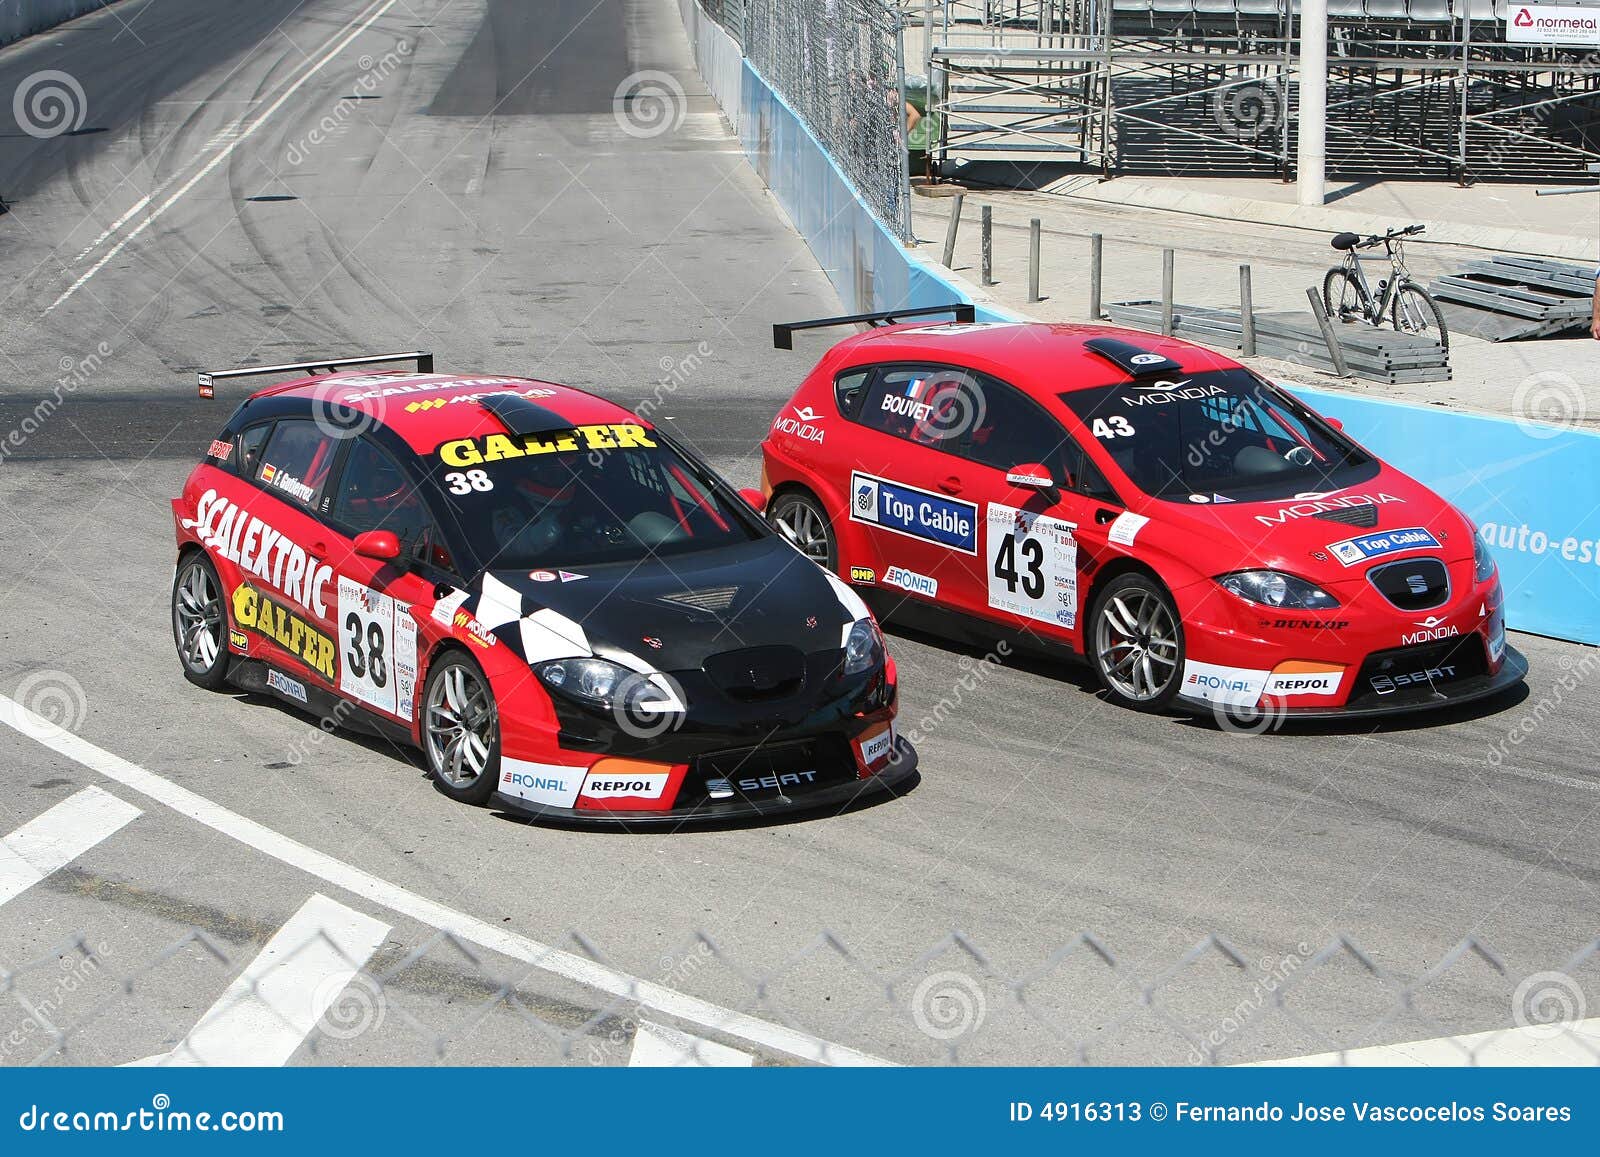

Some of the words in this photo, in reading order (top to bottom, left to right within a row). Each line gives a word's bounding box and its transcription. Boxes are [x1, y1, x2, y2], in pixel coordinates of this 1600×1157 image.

[1536, 18, 1598, 29] normetal
[880, 393, 934, 422] BOUVET
[1121, 384, 1228, 407] MONDIA
[773, 416, 826, 445] MONDIA
[1092, 415, 1136, 439] 43
[439, 424, 658, 467] GALFER
[445, 469, 495, 495] 38
[882, 491, 915, 526] Top
[919, 502, 970, 537] Cable
[1254, 492, 1407, 527] MONDIA
[1358, 539, 1391, 552] Top
[1391, 527, 1431, 545] Cable
[181, 488, 334, 619] SCALEXTRIC
[994, 532, 1045, 600] 43
[851, 567, 874, 582] OMP
[893, 569, 936, 596] RONAL
[231, 582, 335, 679] GALFER
[465, 619, 498, 646] MONLAU
[1273, 618, 1350, 631] DUNLOP
[1401, 625, 1460, 646] MONDIA
[345, 611, 387, 689] 38
[274, 672, 306, 700] RONAL
[1197, 675, 1253, 693] RONAL
[1273, 678, 1330, 690] REPSOL
[1395, 665, 1456, 686] SEAT
[511, 771, 568, 792] RONAL
[590, 780, 653, 792] REPSOL
[737, 769, 817, 791] SEAT
